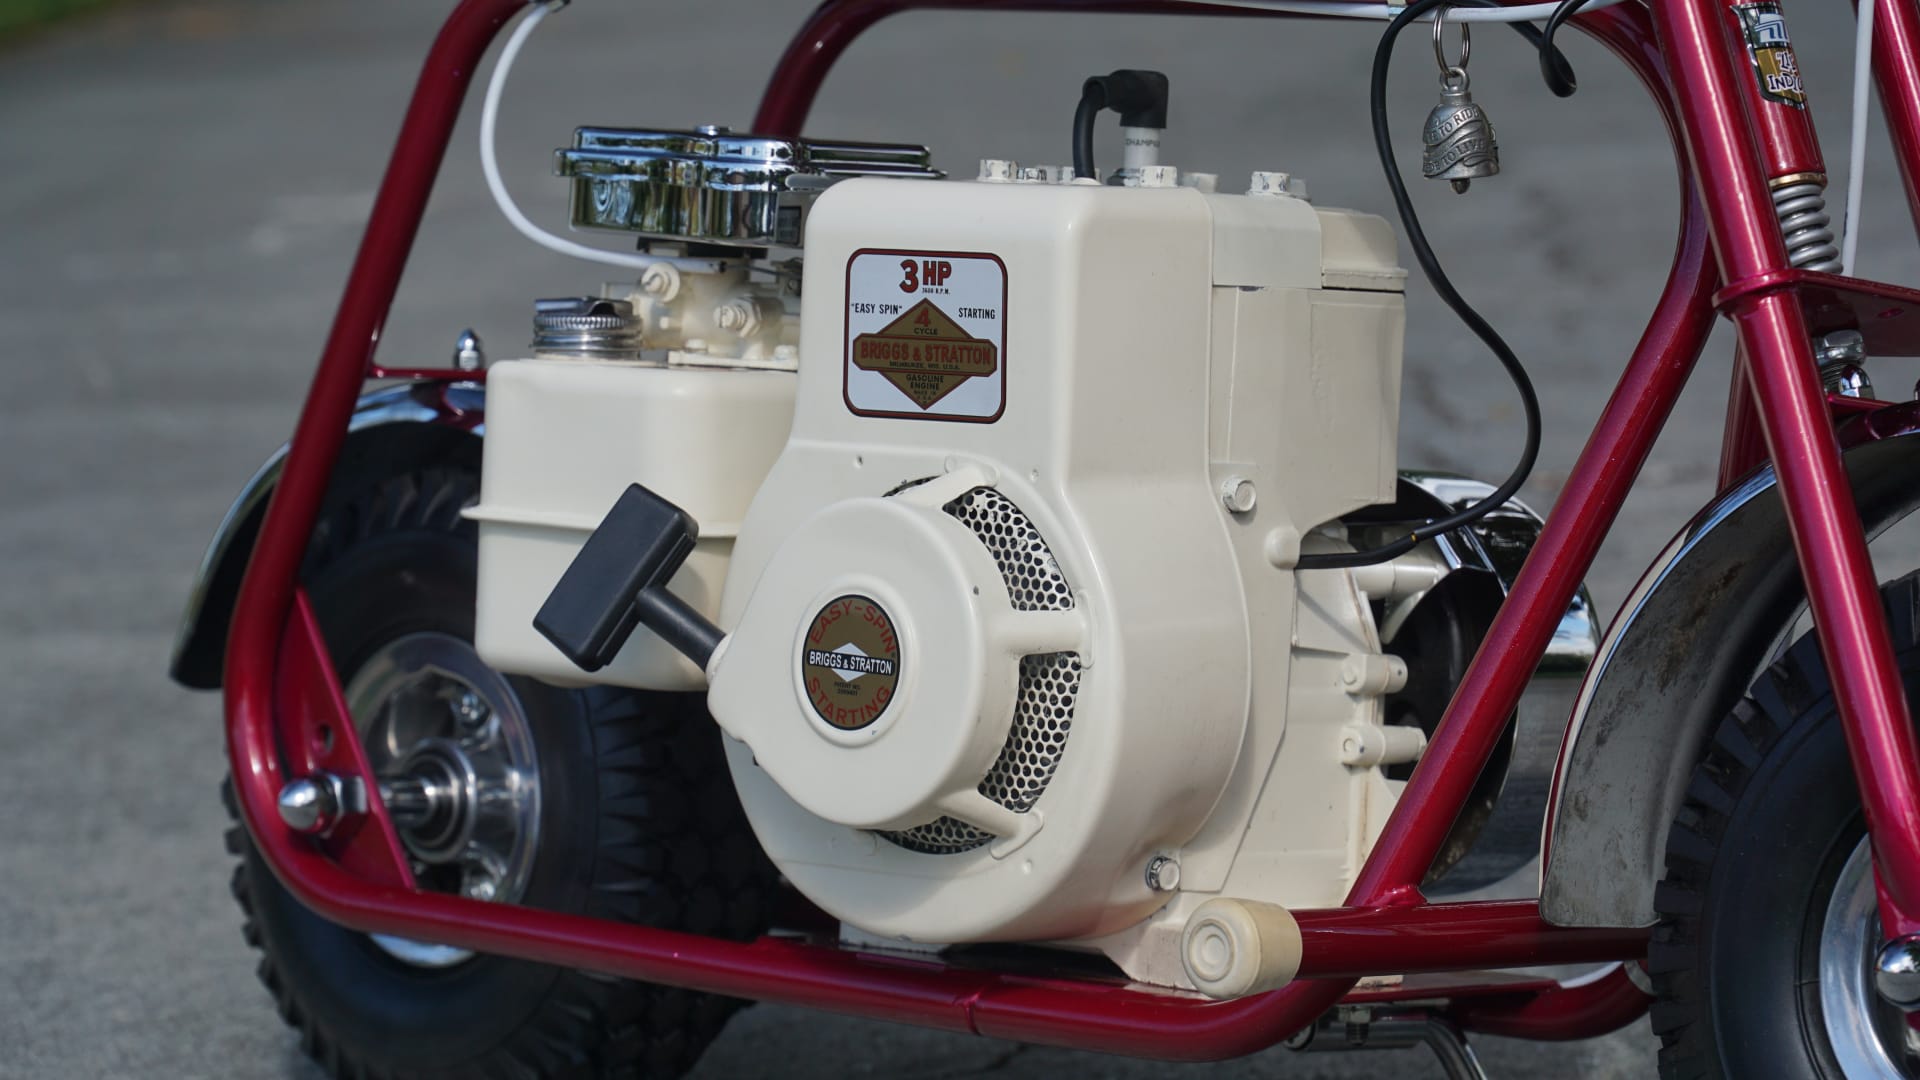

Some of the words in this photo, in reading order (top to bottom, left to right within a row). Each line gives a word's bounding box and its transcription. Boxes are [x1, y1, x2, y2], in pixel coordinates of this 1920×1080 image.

[1439, 121, 1453, 137] TO
[1441, 151, 1456, 166] TO
[899, 259, 919, 293] 3
[922, 260, 952, 286] HP
[914, 307, 931, 327] 4
[958, 307, 996, 320] STARTING
[914, 327, 938, 336] CYCLE
[860, 340, 909, 361] BRIGGS
[912, 347, 922, 362] &
[925, 344, 992, 365] STRATTON
[906, 374, 944, 383] GASOLINE
[910, 382, 939, 391] ENGINE
[809, 650, 842, 668] BRIGGS
[843, 659, 849, 669] &
[850, 656, 893, 675] STRATTON
[808, 677, 890, 725] STARTING
